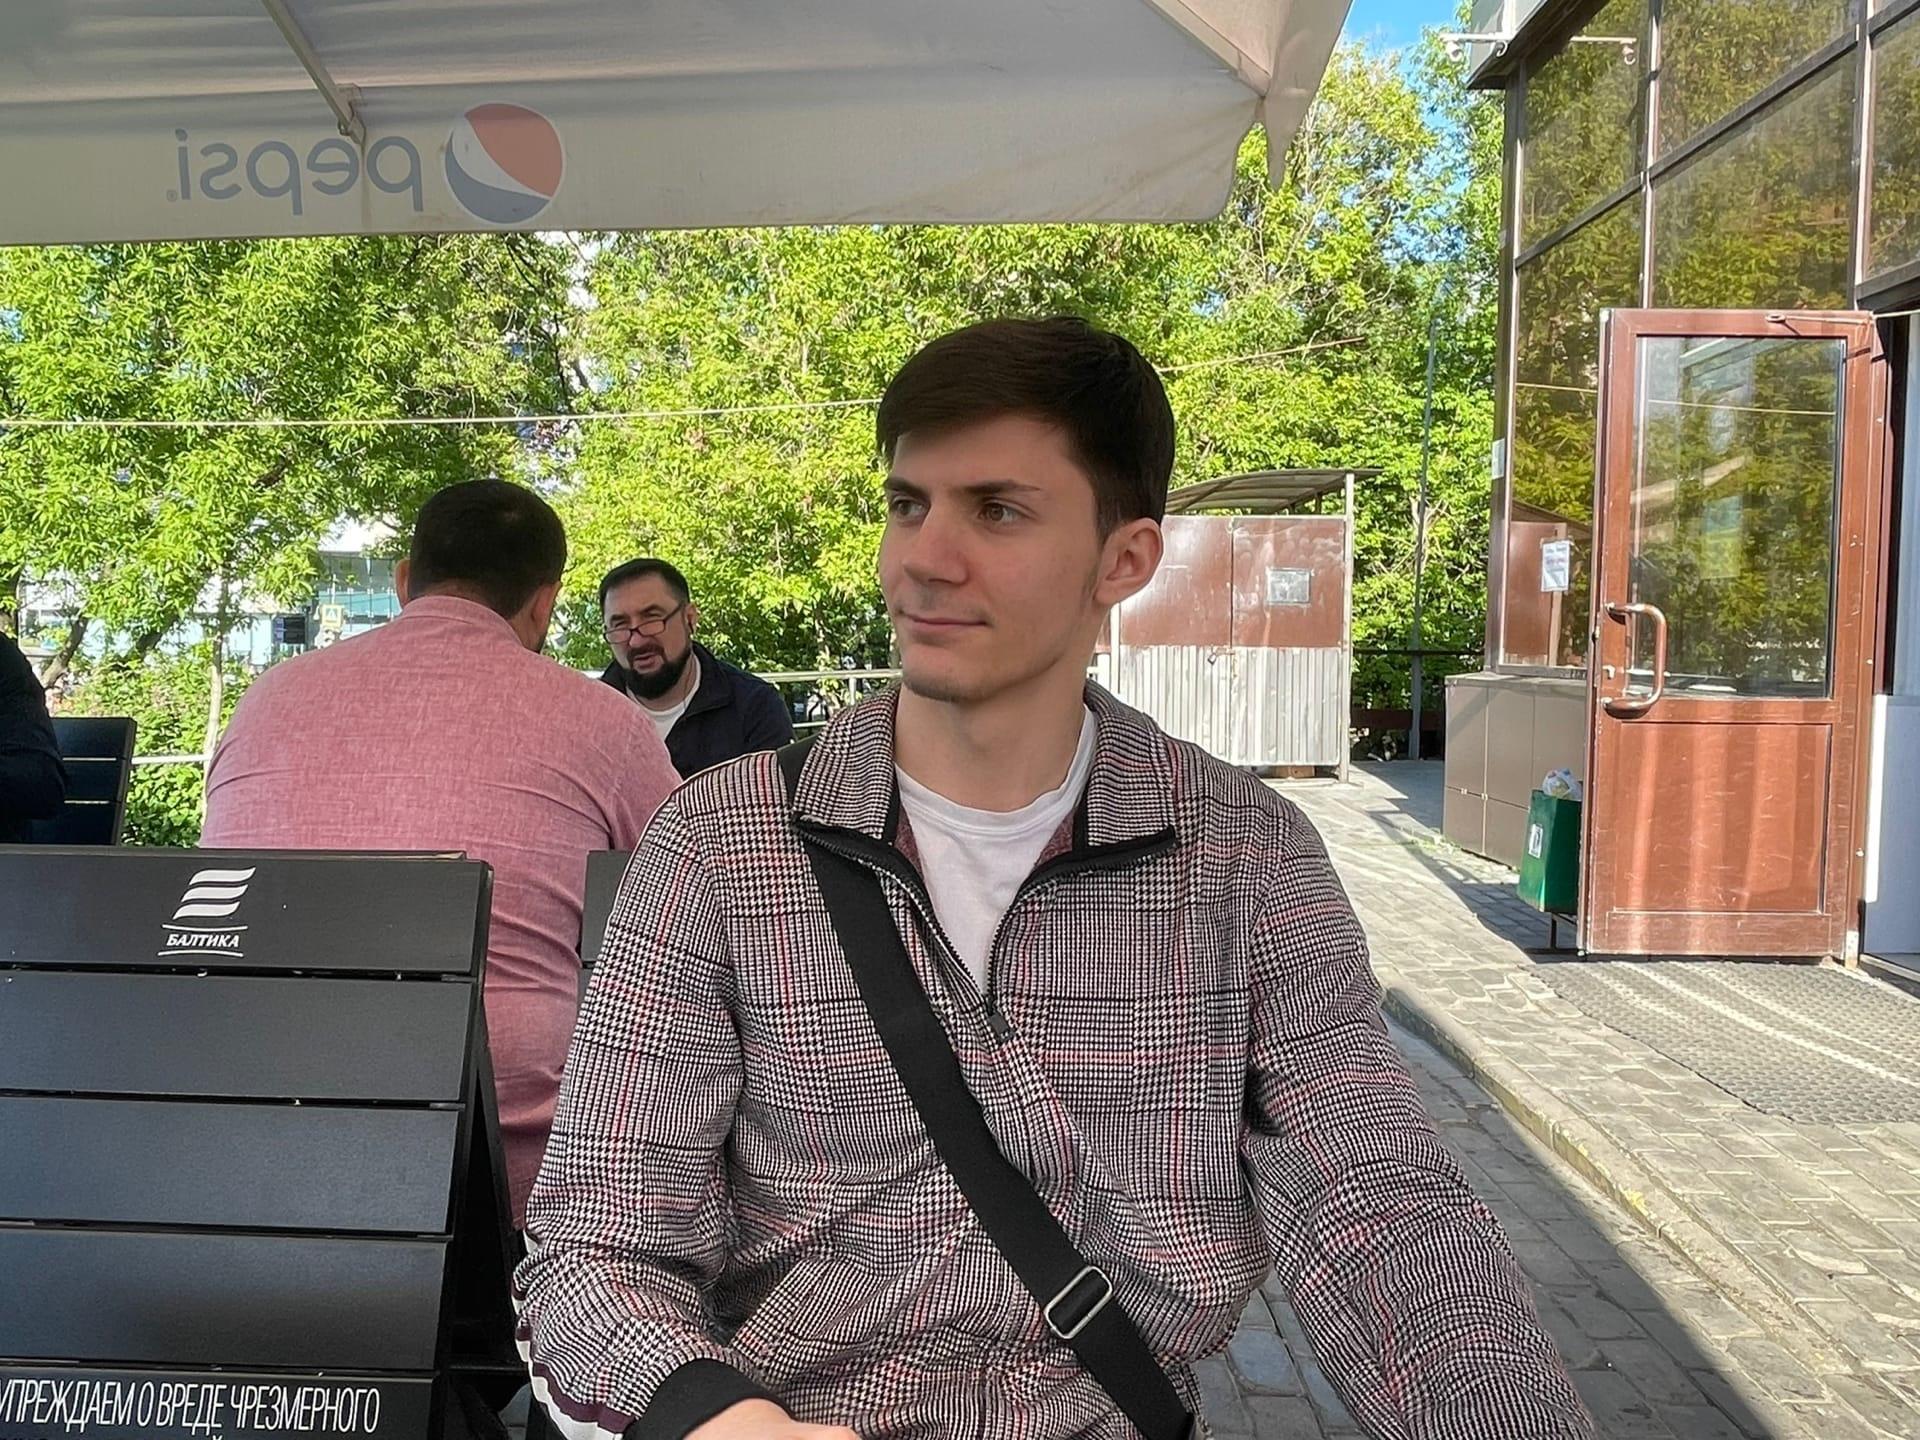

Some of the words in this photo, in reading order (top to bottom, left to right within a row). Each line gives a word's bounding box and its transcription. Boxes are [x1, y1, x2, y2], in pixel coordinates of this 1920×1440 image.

[166, 934, 240, 947] БАЛТИКА
[137, 1381, 154, 1427] О
[156, 1383, 227, 1436] ВРЕДЕ
[231, 1385, 380, 1433] ЧРЕЗМЕРНОГО
